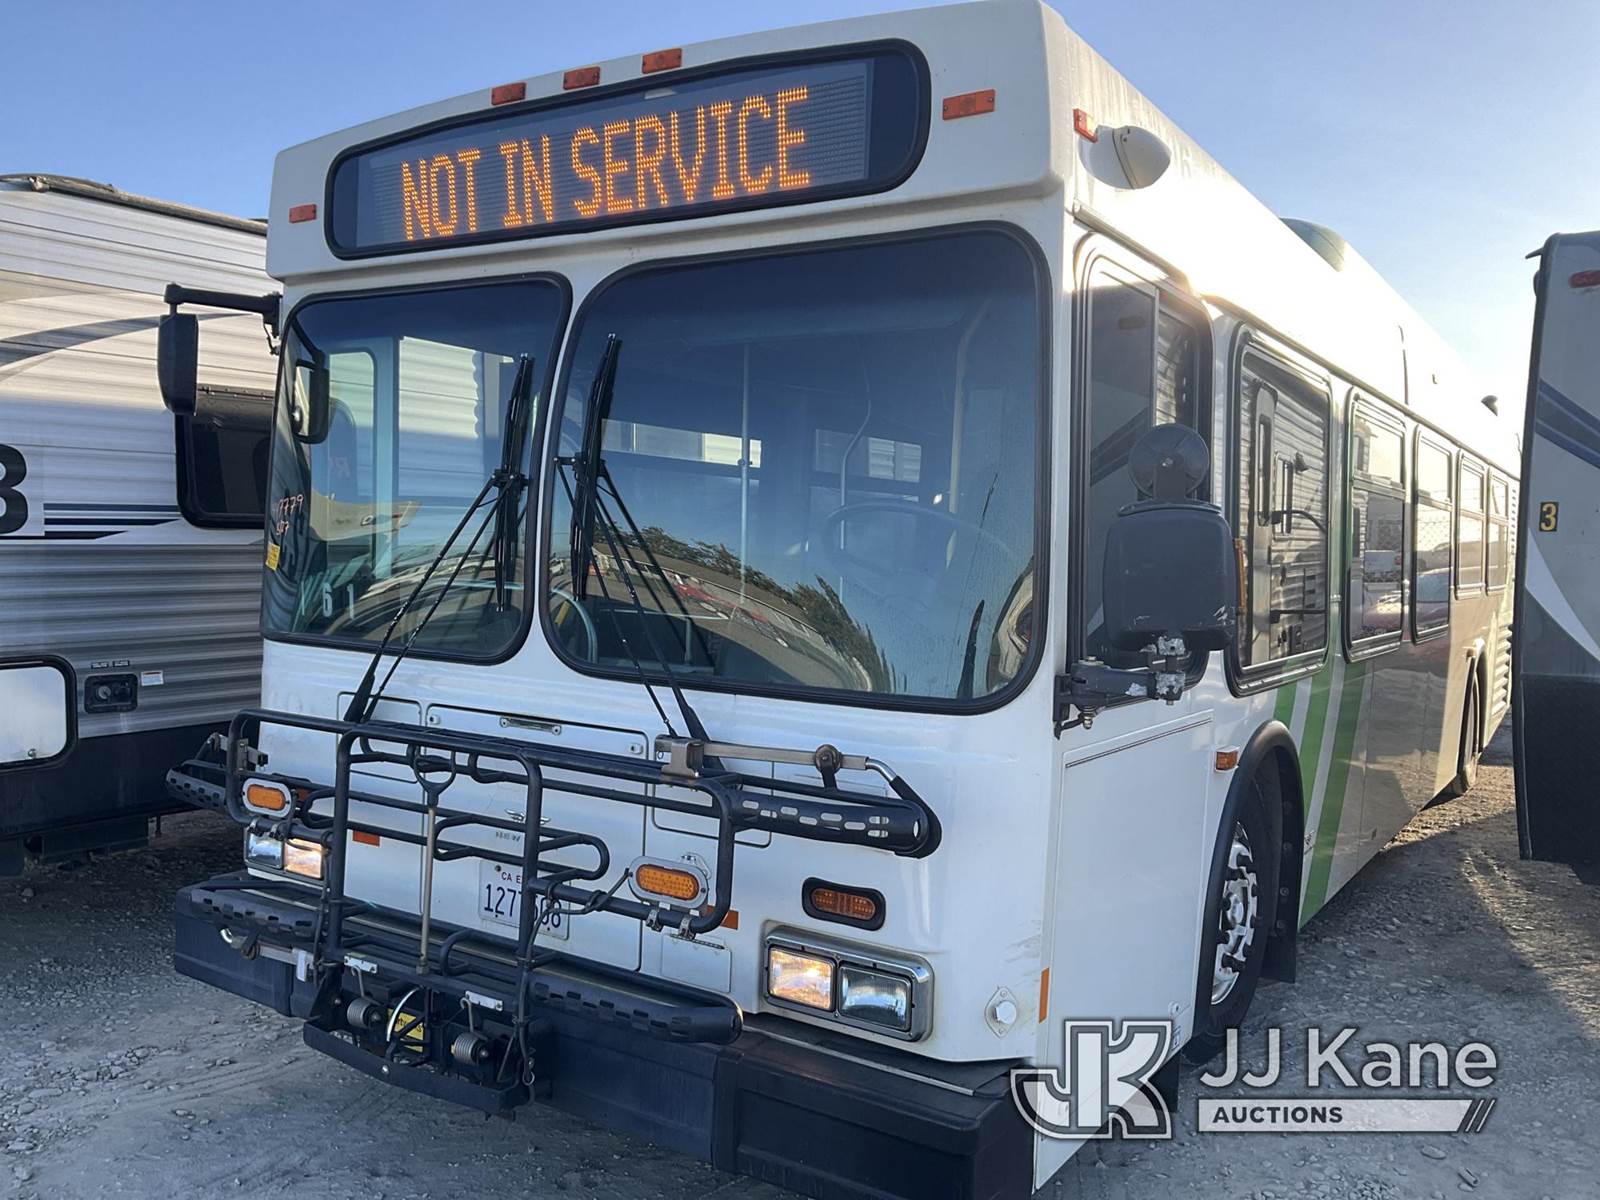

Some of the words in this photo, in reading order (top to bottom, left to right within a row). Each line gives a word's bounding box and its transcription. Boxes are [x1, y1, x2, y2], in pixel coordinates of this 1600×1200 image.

[402, 150, 480, 240] NOT
[500, 136, 552, 226] IN
[571, 87, 809, 215] SERVICE
[1541, 503, 1557, 531] 3
[501, 871, 512, 882] CA
